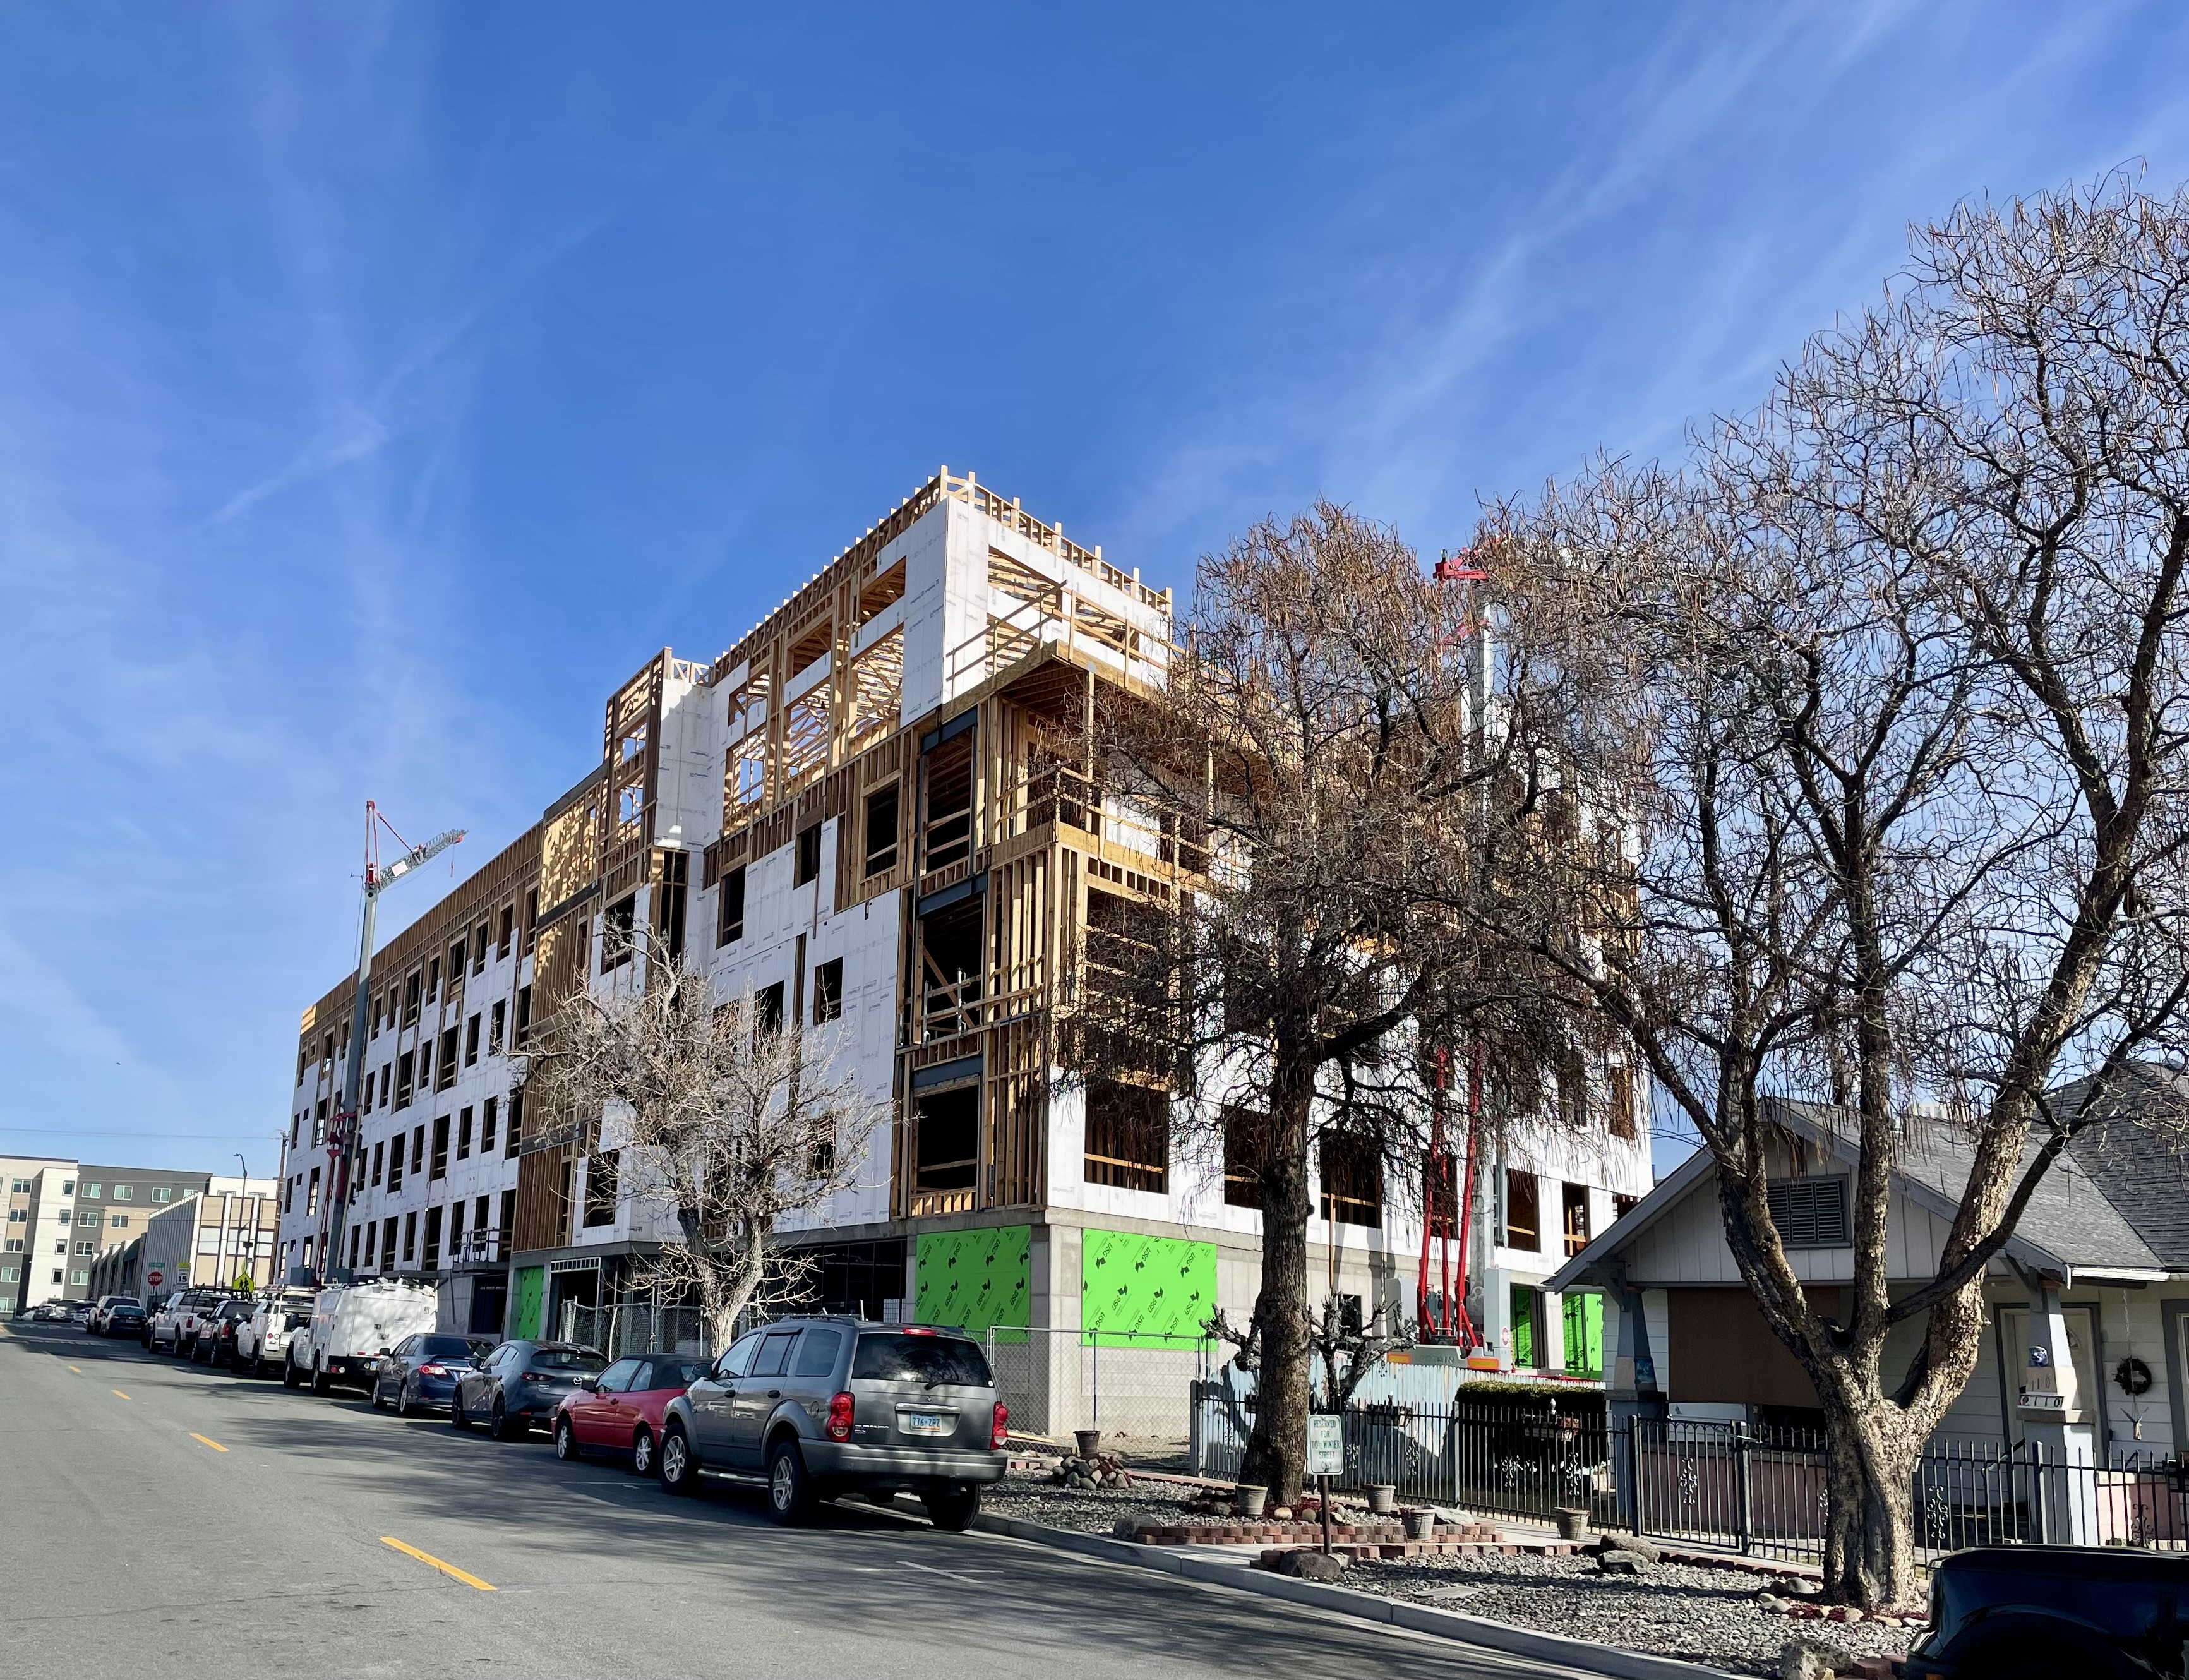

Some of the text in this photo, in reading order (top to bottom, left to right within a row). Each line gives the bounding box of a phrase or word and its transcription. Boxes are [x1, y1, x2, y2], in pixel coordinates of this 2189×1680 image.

[954, 1242, 962, 1257] USG
[992, 1239, 1000, 1254] USG
[1103, 1242, 1113, 1257] USG
[1142, 1247, 1151, 1261] USG
[1187, 1252, 1196, 1266] USG
[945, 1292, 953, 1307] USG
[977, 1290, 985, 1306] USG
[1010, 1290, 1018, 1305] USG
[1111, 1295, 1121, 1311] USG
[1148, 1298, 1157, 1314] USG
[1184, 1301, 1194, 1316] USG
[932, 1309, 940, 1324] USG
[963, 1308, 971, 1324] USG
[996, 1308, 1005, 1324] USG
[1095, 1311, 1105, 1327] USG
[1135, 1314, 1145, 1330] USG
[1170, 1317, 1180, 1331] USG
